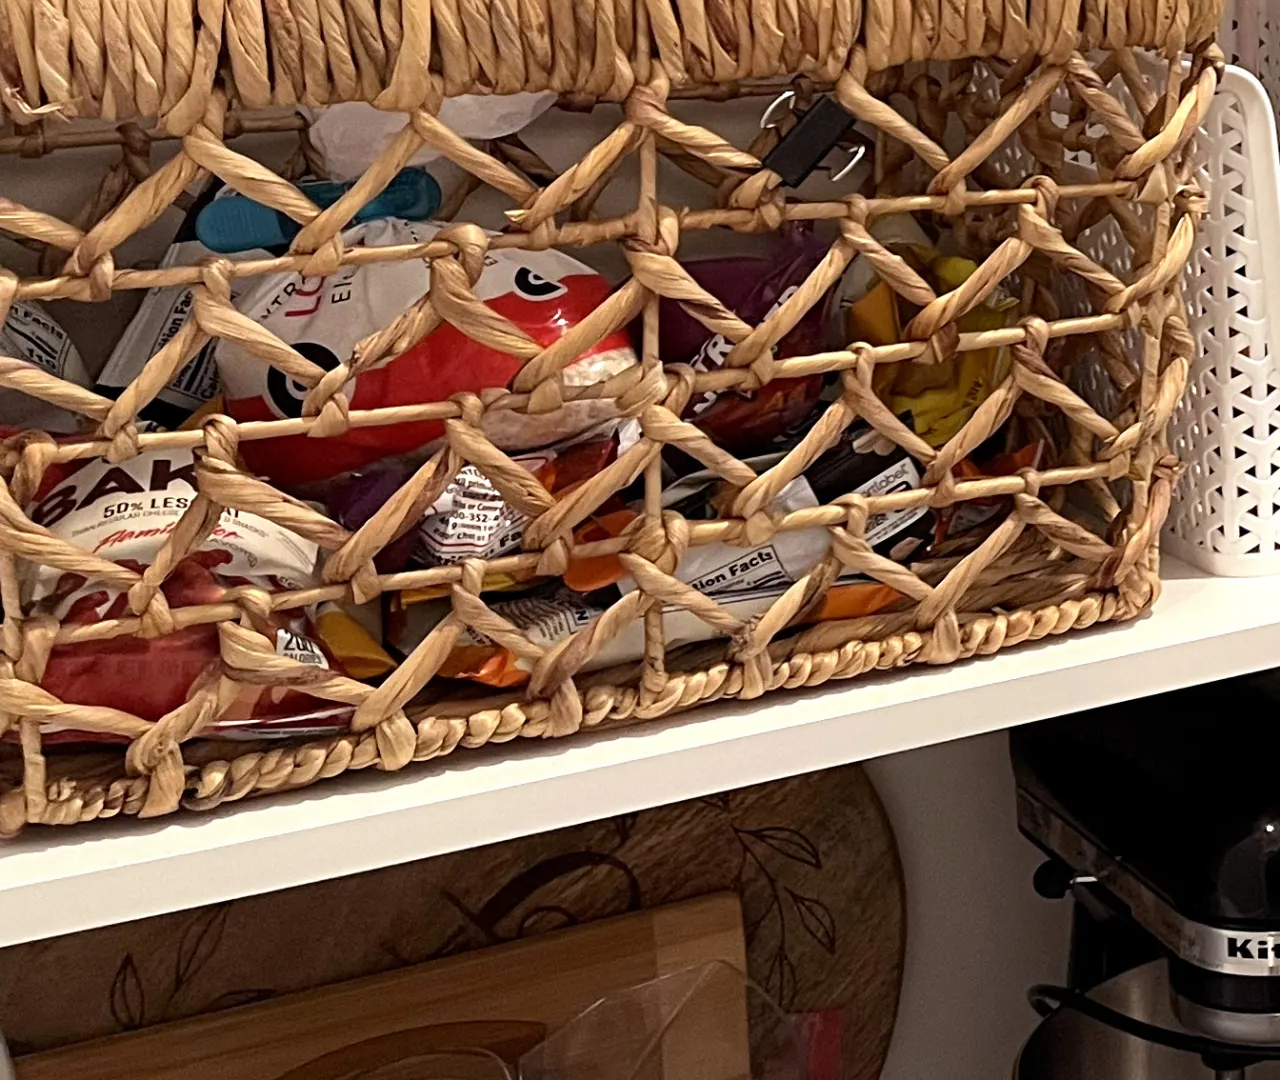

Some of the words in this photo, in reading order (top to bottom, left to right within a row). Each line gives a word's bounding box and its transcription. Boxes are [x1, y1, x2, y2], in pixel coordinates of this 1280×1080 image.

[31, 459, 198, 529] BAK
[103, 499, 144, 520] 50%
[145, 497, 190, 510] LES
[729, 550, 774, 578] Facts
